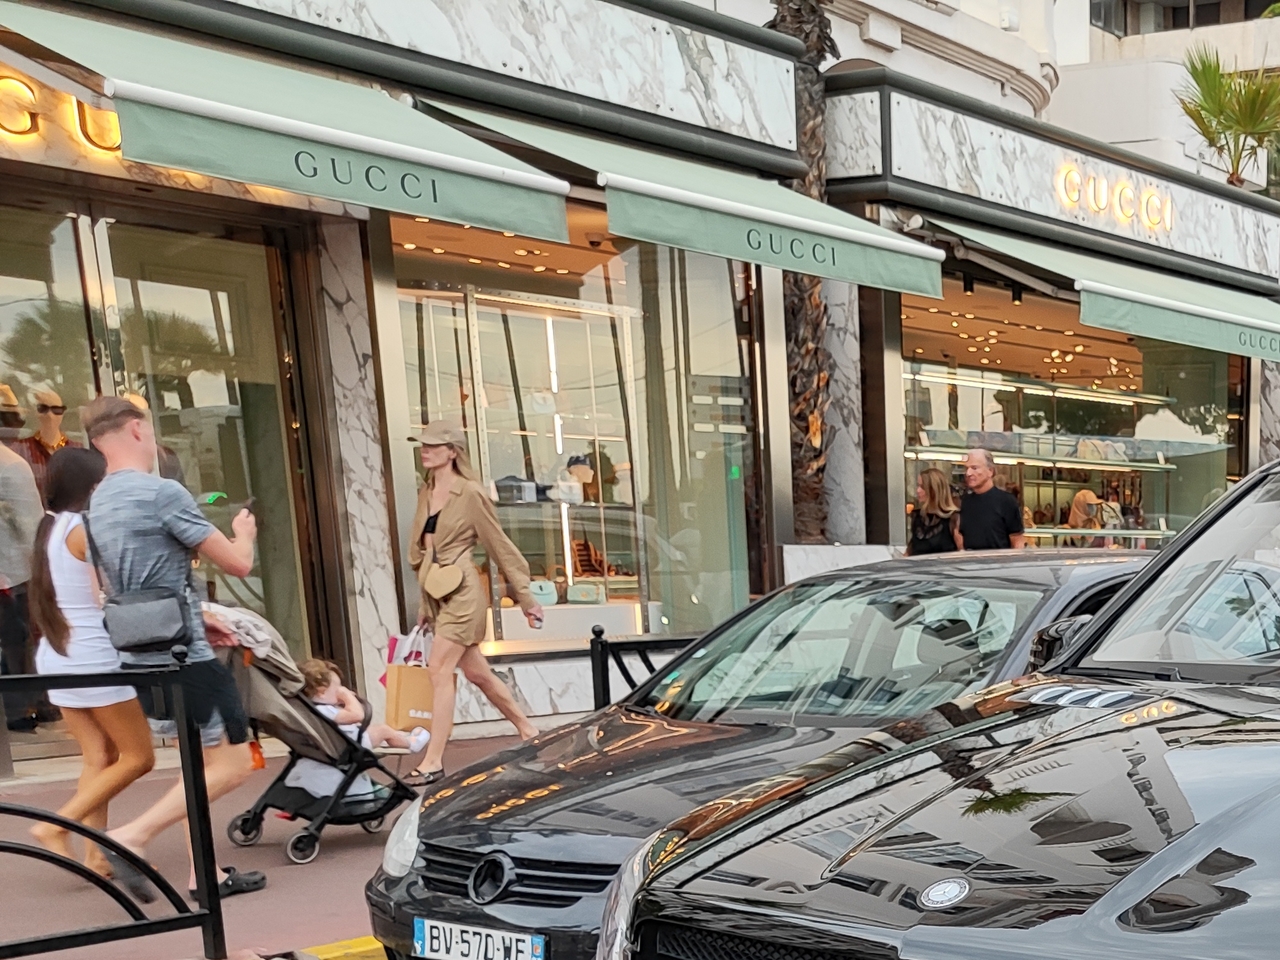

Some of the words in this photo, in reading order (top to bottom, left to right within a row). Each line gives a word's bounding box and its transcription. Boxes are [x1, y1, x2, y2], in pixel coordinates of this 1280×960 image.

[294, 150, 437, 203] GUCCI
[1058, 165, 1173, 232] GUCCI
[746, 228, 836, 266] GUCCI
